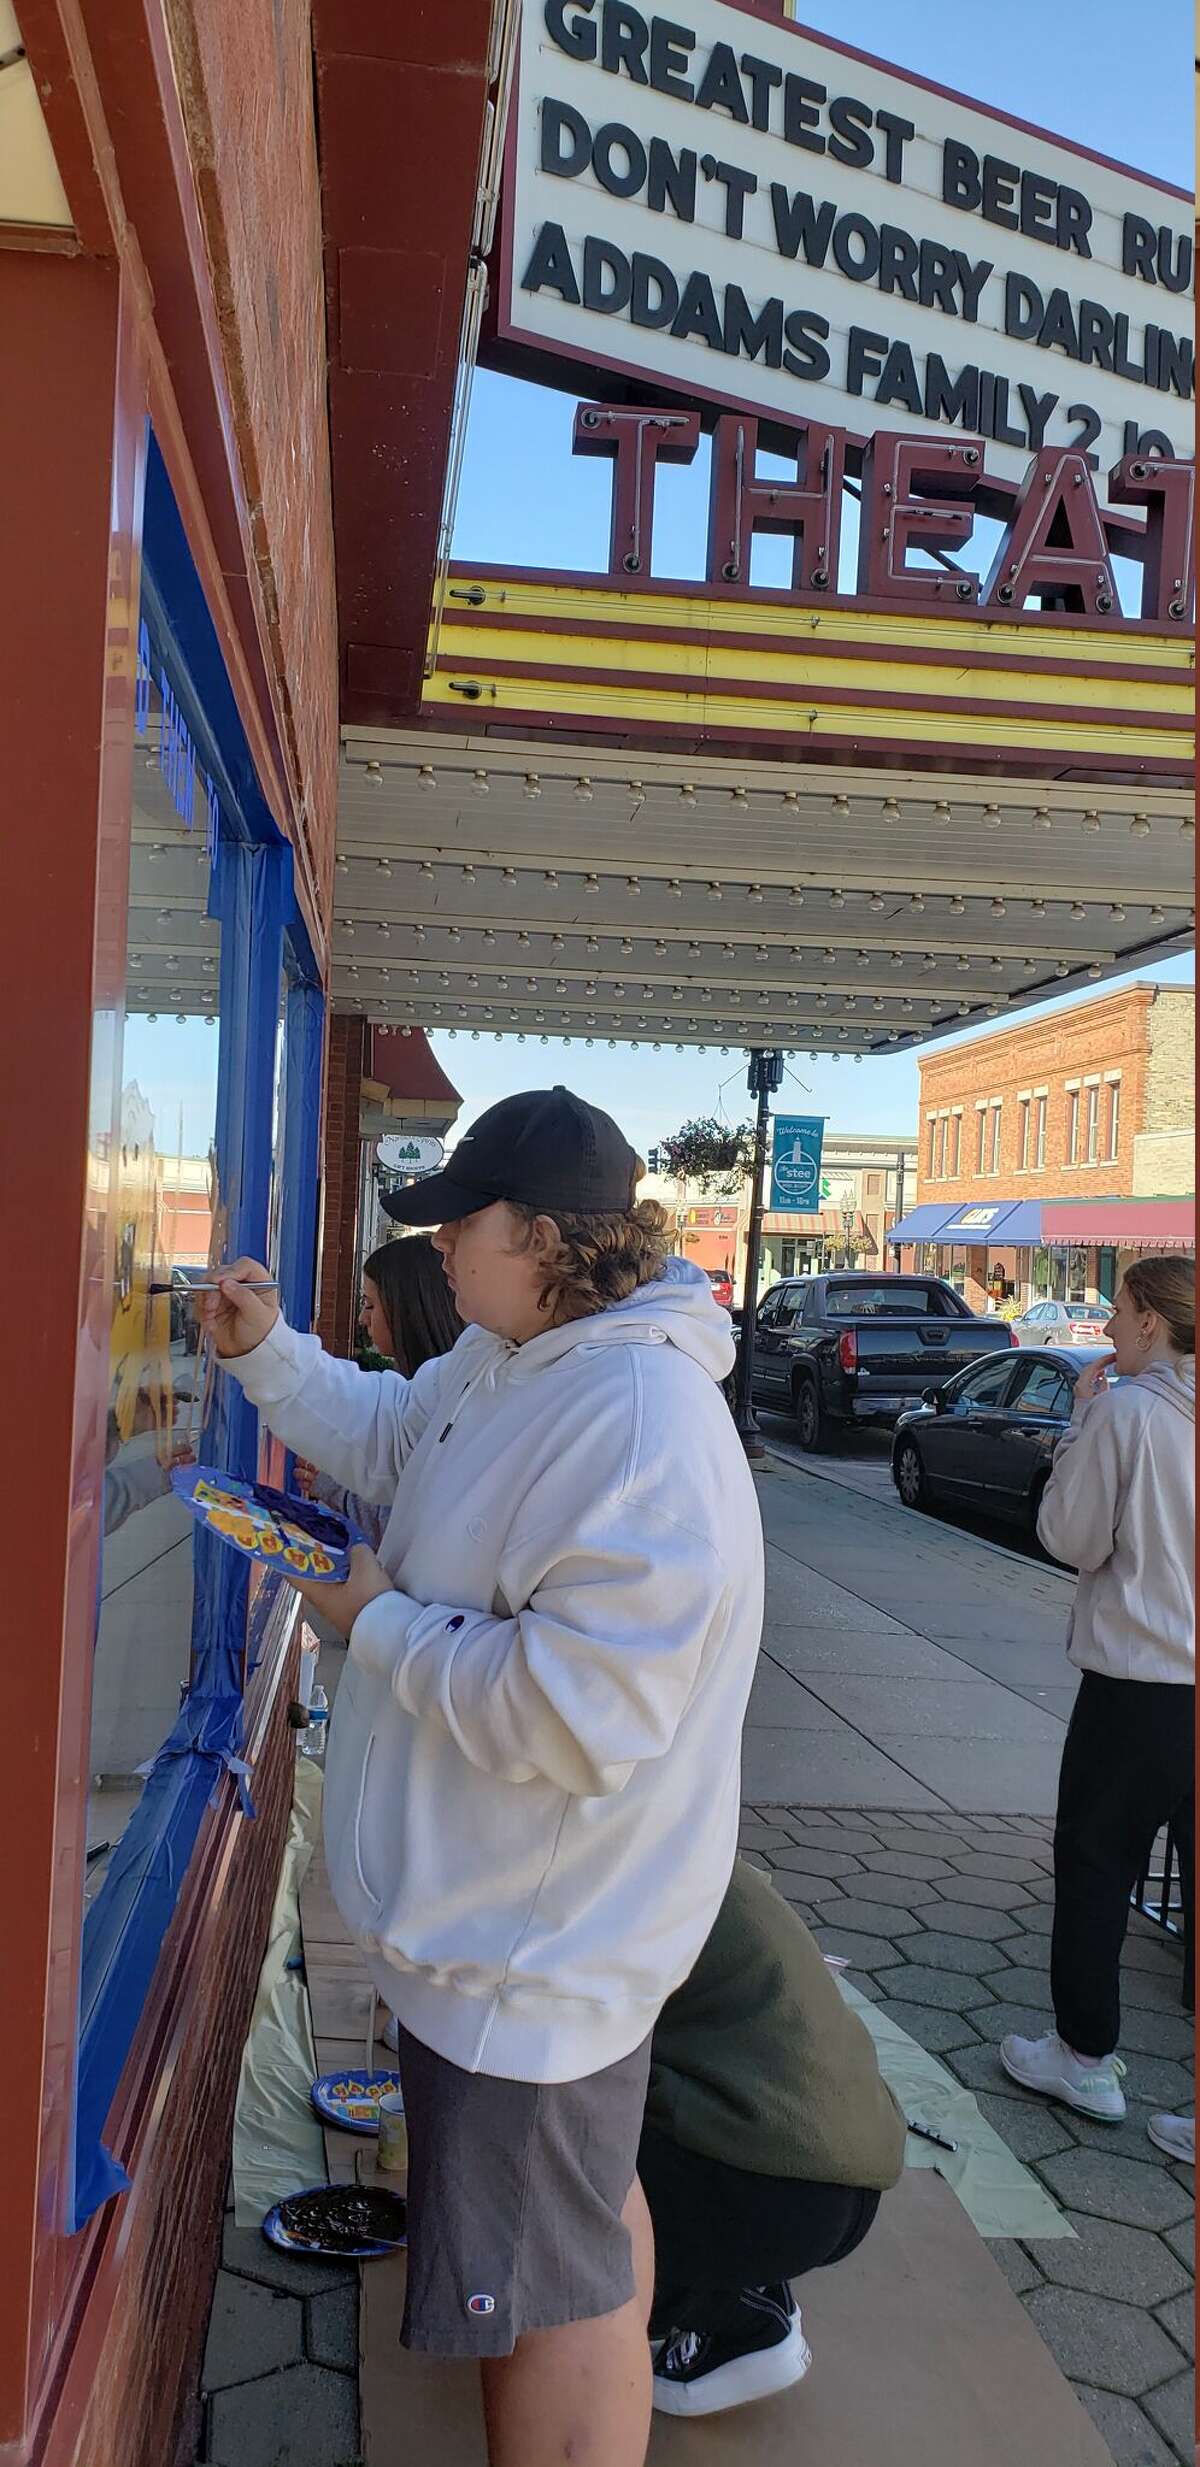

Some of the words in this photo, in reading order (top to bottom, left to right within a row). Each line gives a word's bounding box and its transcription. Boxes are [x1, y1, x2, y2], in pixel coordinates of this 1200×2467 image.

[541, 97, 757, 240] DON'T
[770, 182, 994, 323] WORRY
[1006, 271, 1194, 399] DARLIN
[545, 0, 914, 184] GREATEST
[942, 138, 1093, 259] BEER
[521, 221, 830, 381] ADDAMS
[847, 325, 1060, 450] FAMILY
[1068, 404, 1101, 471] 2
